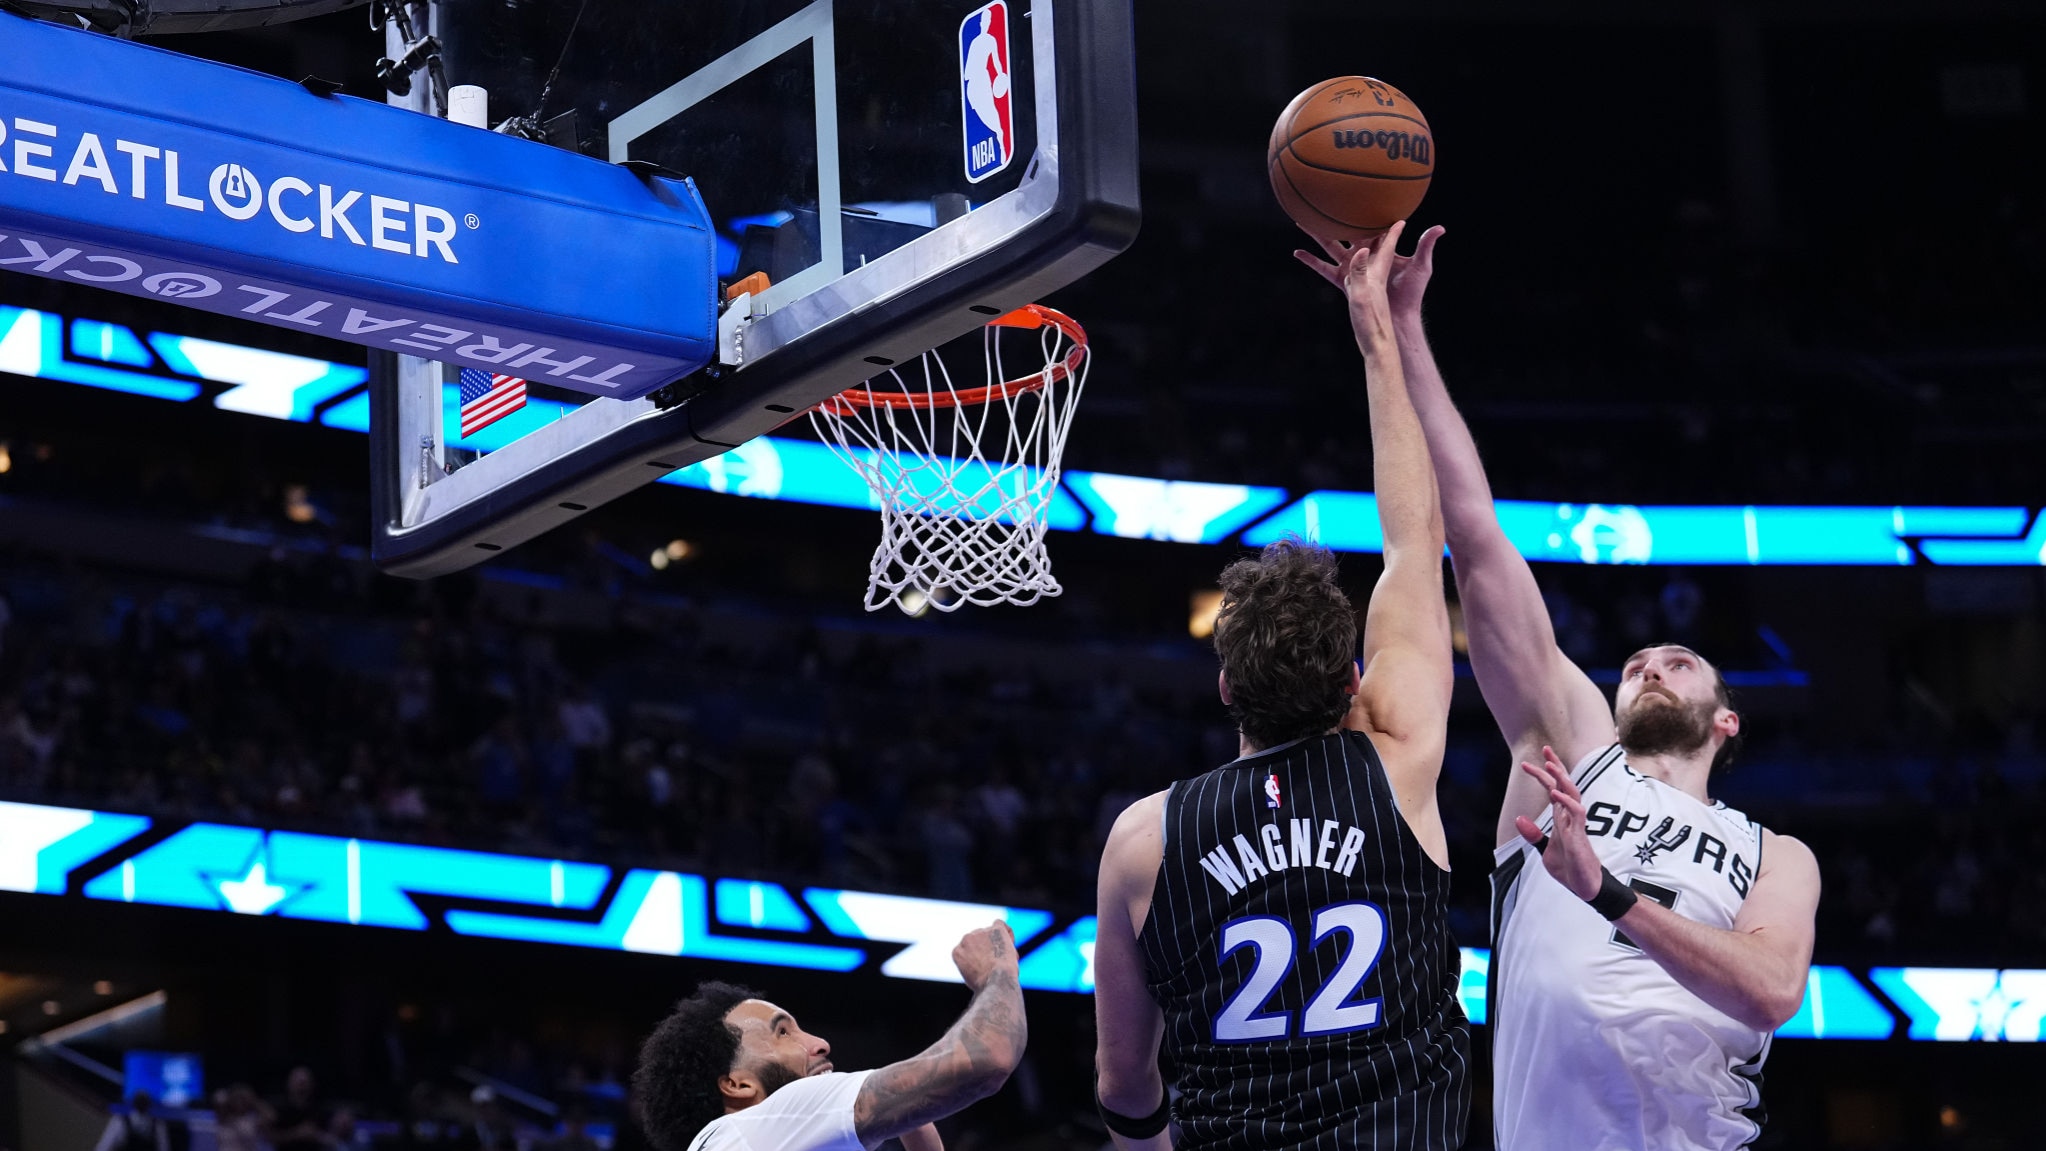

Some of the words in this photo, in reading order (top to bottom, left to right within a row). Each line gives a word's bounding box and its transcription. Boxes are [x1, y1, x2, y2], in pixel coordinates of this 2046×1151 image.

[972, 136, 996, 171] NBA
[1333, 127, 1430, 166] Wilson
[0, 234, 636, 389] THREATLOCK
[1200, 818, 1366, 896] WAGNER
[1585, 801, 1753, 901] SPURS
[1212, 901, 1388, 1044] 22
